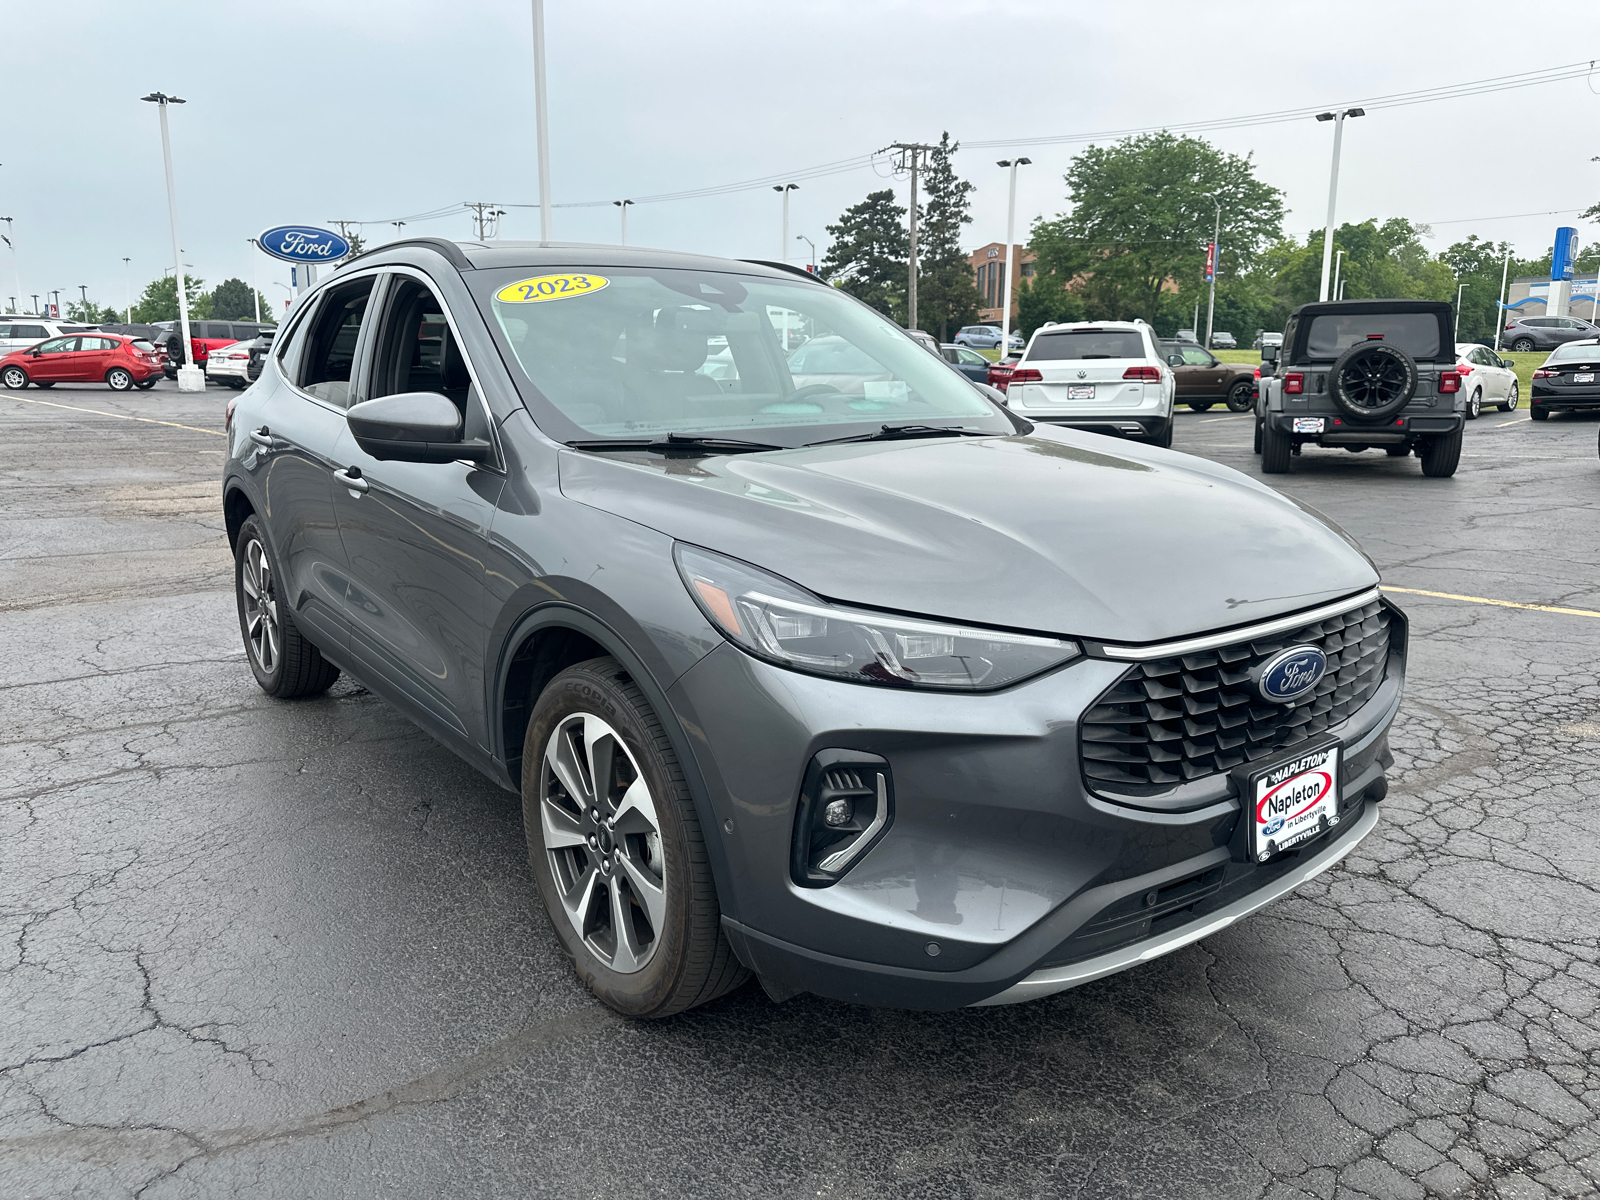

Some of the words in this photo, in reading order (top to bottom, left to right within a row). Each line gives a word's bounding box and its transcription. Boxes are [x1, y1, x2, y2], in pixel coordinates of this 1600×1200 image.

[280, 231, 333, 256] Ford
[518, 276, 592, 300] 2023
[1280, 658, 1317, 692] Ford
[1274, 753, 1326, 784] NAPLETON
[1268, 782, 1320, 818] Napleton
[1287, 821, 1294, 829] in
[1294, 805, 1327, 826] Libertyville
[1278, 825, 1321, 851] LIBERTYVILLE
